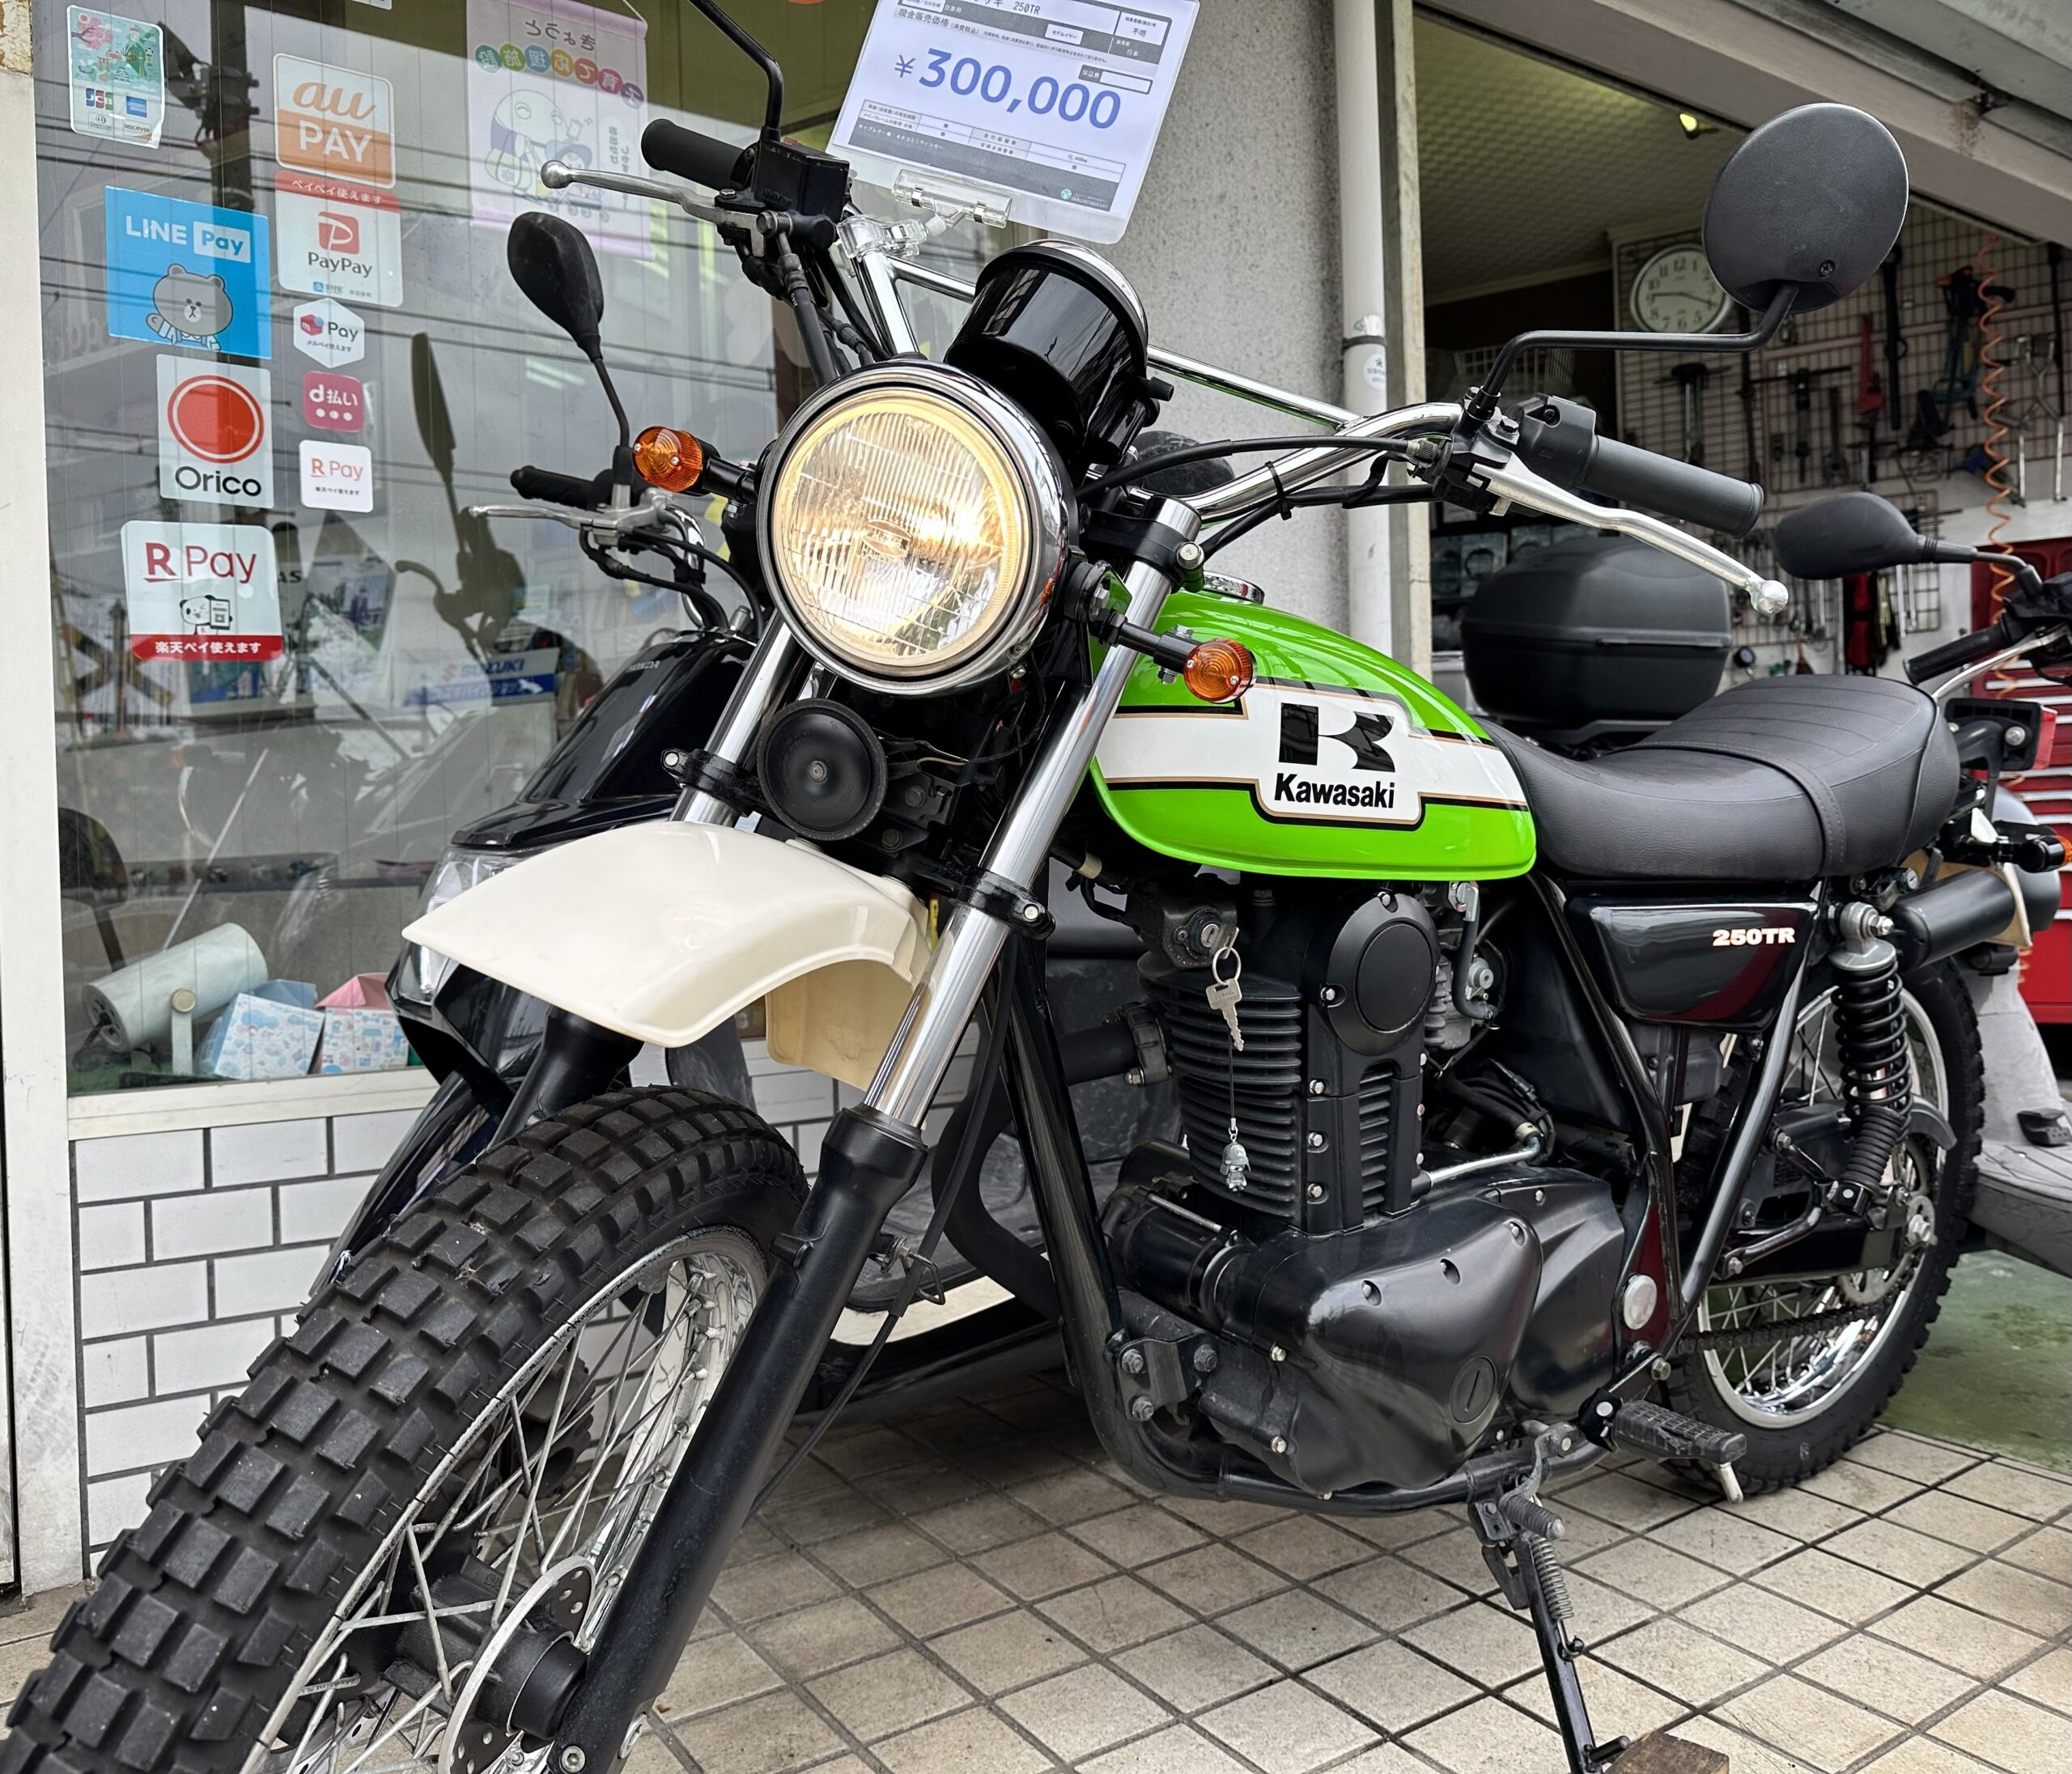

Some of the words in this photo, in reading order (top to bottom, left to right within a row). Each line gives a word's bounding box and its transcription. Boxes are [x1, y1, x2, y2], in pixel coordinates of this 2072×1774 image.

[898, 8, 949, 27] 現金販売価格
[1013, 1, 1041, 15] 250TR
[293, 82, 376, 121] au
[299, 120, 373, 163] PAY
[292, 180, 382, 204] ペイペイ使えます
[125, 215, 187, 245] LINE
[201, 228, 244, 256] Pay
[308, 252, 372, 278] PayPay
[328, 321, 359, 342] Pay
[307, 339, 352, 353] メルペイ使えます
[308, 384, 358, 405] d払い
[175, 465, 261, 497] Orico
[329, 460, 363, 481] Pay
[315, 486, 360, 496] 楽天ペイ使えます
[185, 545, 257, 584] Pay
[155, 640, 261, 655] 楽天ペイ使えます
[1274, 772, 1395, 808] Kawasaki
[1712, 927, 1796, 947] 250TR
